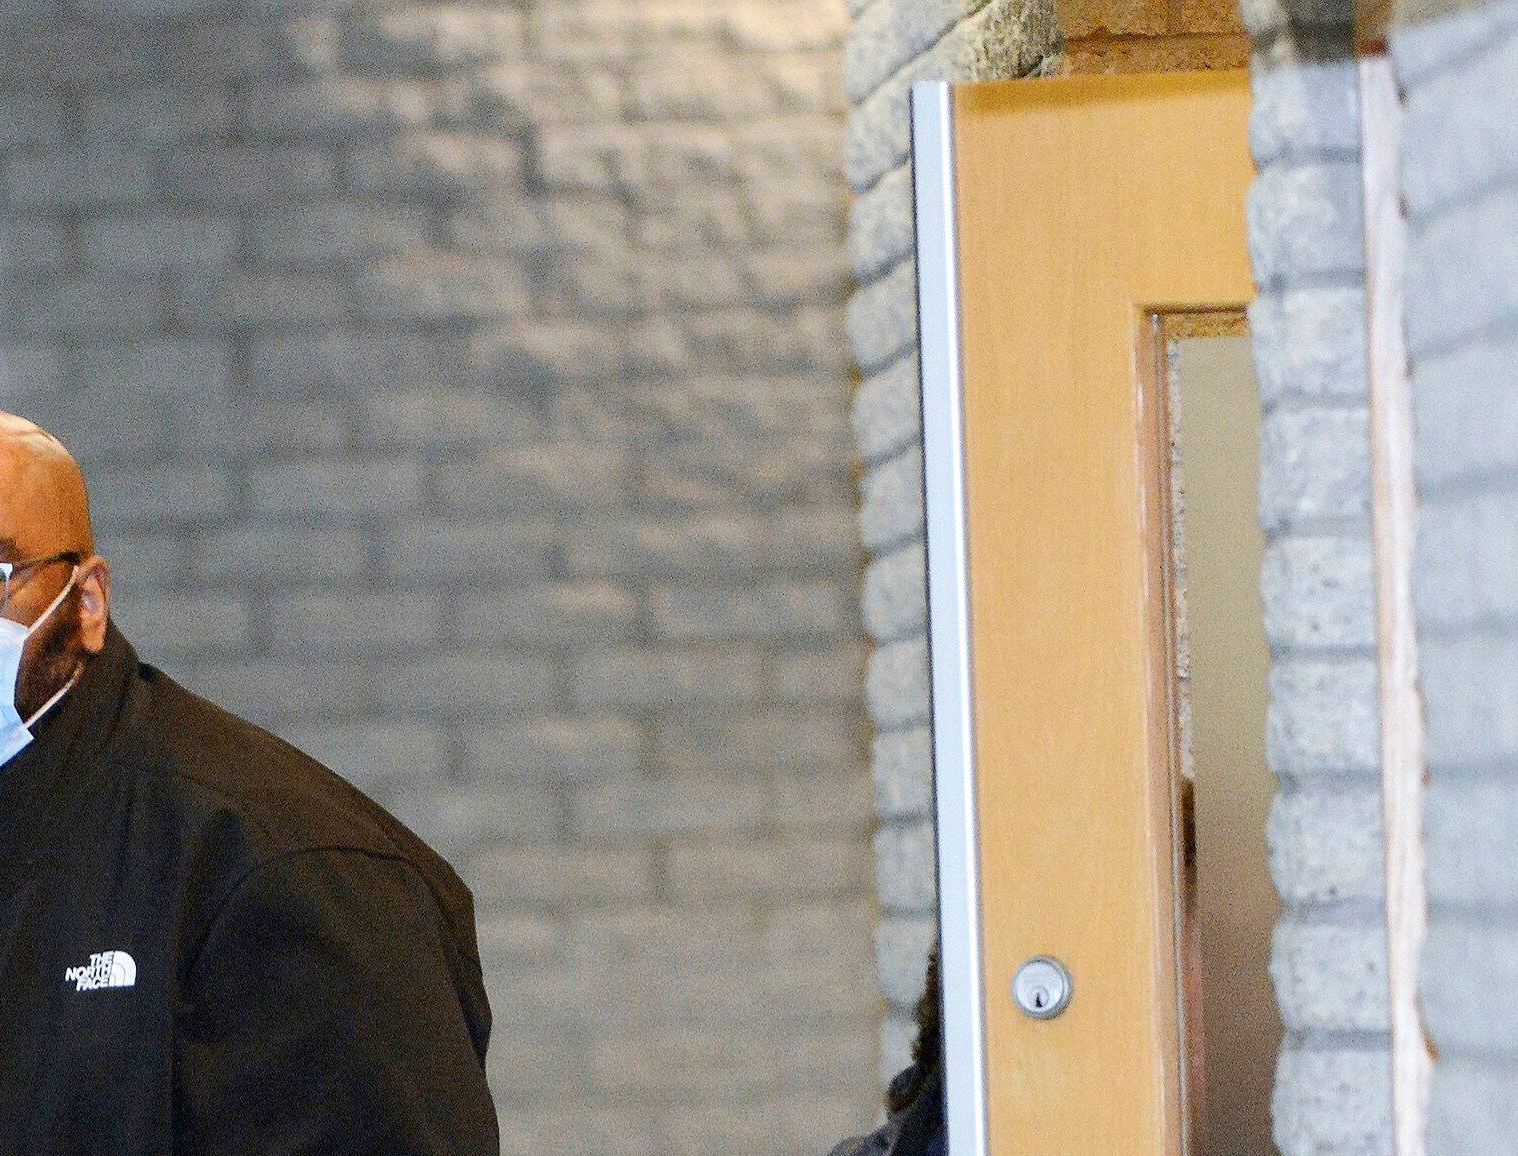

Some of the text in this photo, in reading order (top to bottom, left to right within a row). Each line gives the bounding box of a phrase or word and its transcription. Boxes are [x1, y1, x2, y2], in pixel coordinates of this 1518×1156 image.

[89, 951, 114, 967] THE
[65, 963, 112, 981] NORTH
[76, 976, 110, 991] FACE
